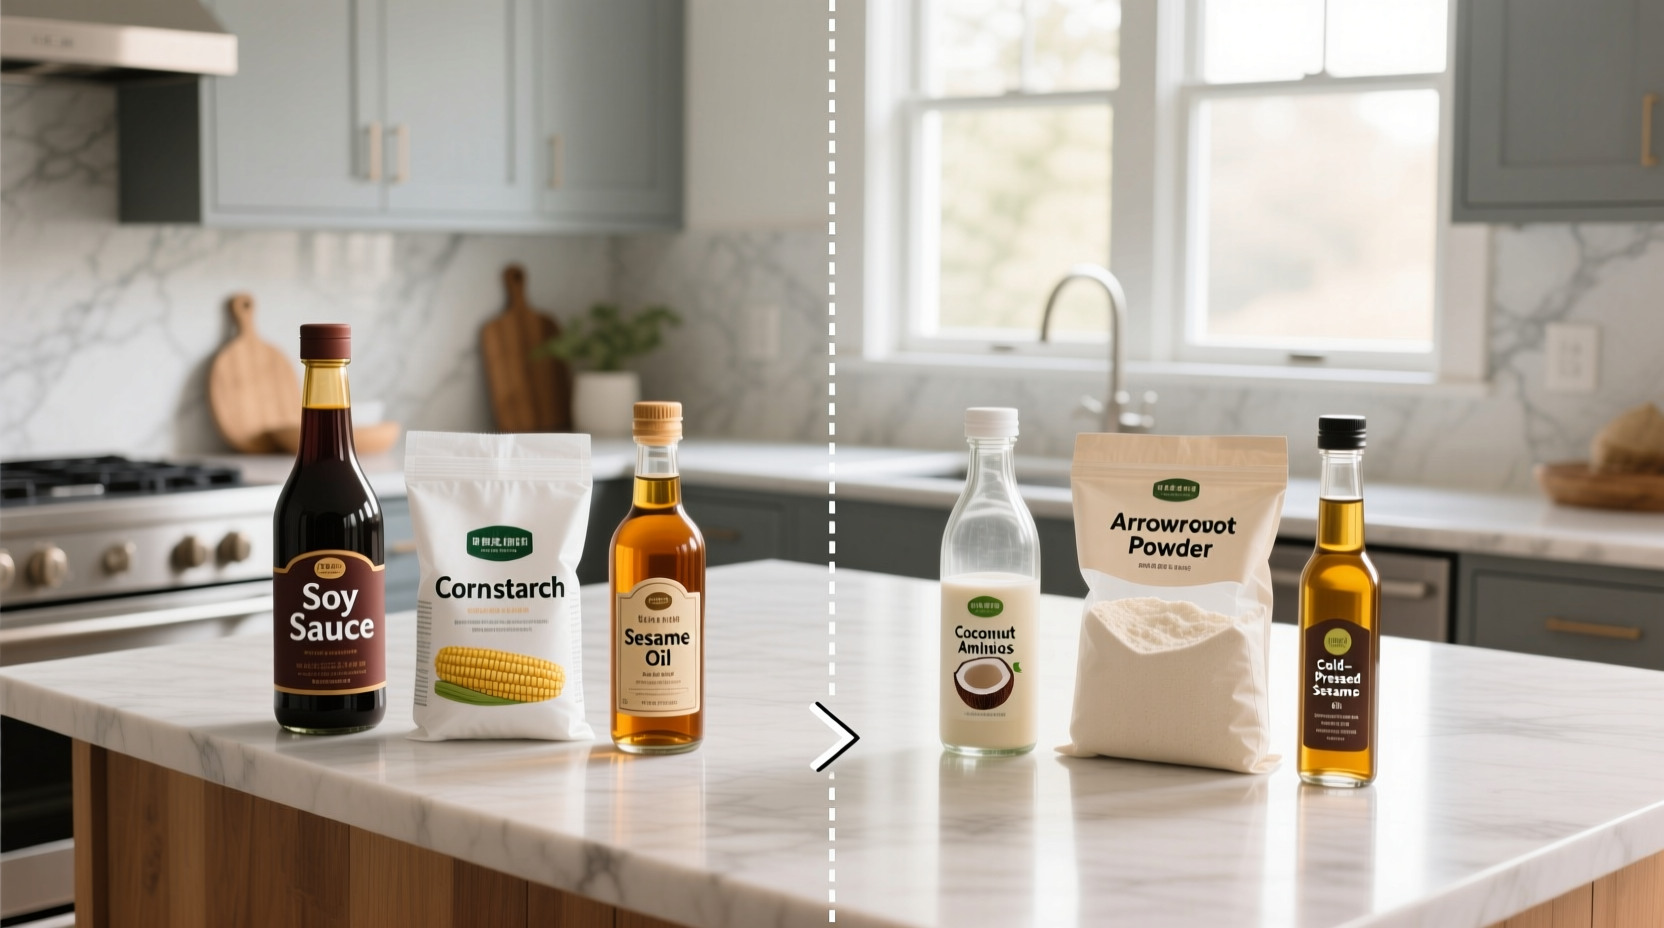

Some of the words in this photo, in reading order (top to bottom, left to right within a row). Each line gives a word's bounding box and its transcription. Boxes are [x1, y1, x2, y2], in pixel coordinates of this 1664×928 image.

[1128, 535, 1214, 558] Powder
[435, 575, 565, 599] Cornstarch
[302, 582, 359, 617] Soy
[289, 612, 375, 642] Sauce
[624, 628, 690, 646] Sesame
[645, 648, 671, 666] Oil
